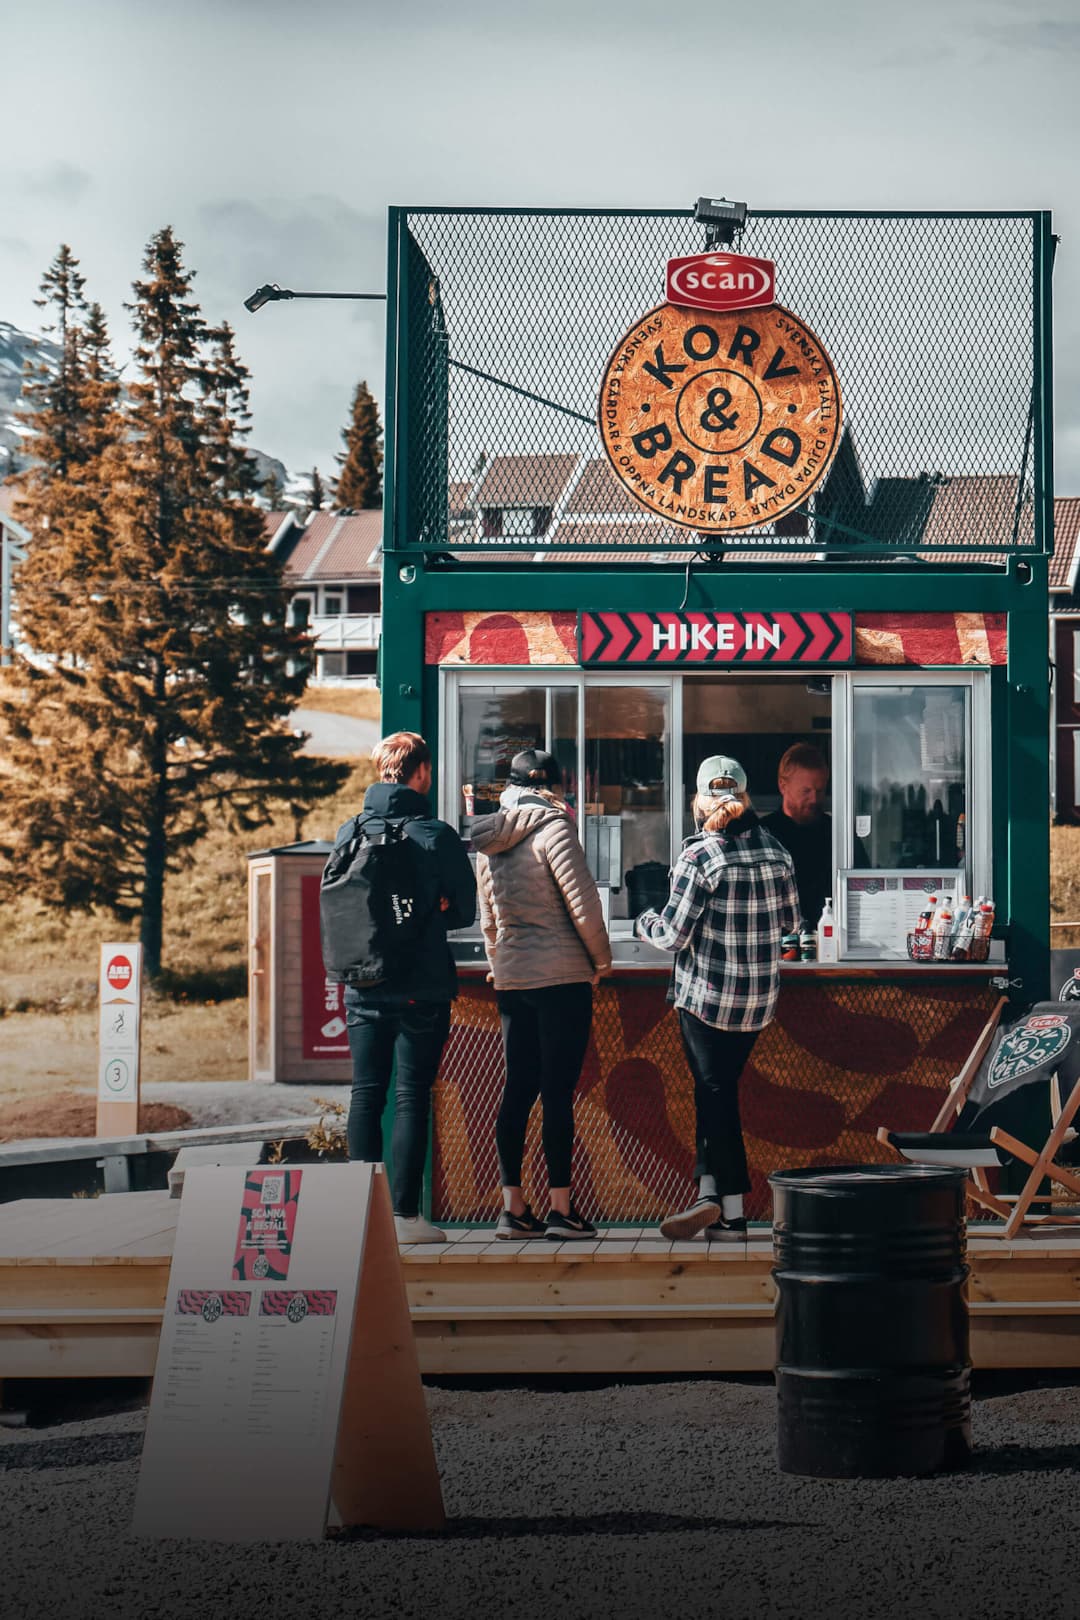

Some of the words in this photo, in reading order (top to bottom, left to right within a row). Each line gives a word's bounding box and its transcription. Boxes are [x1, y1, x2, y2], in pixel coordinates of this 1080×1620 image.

[686, 271, 755, 290] scan
[615, 317, 663, 372] SVENSKA
[643, 324, 800, 390] KORV
[775, 318, 823, 376] SVENSKA
[700, 387, 740, 433] &
[619, 454, 656, 499] ÖPPNA
[631, 422, 801, 504] BREAD
[794, 439, 826, 483] DJUPA
[658, 495, 737, 521] LANDSKAP
[750, 483, 796, 516] DALAR
[652, 623, 734, 651] HIKE
[745, 623, 781, 651] IN
[112, 1067, 121, 1082] 3
